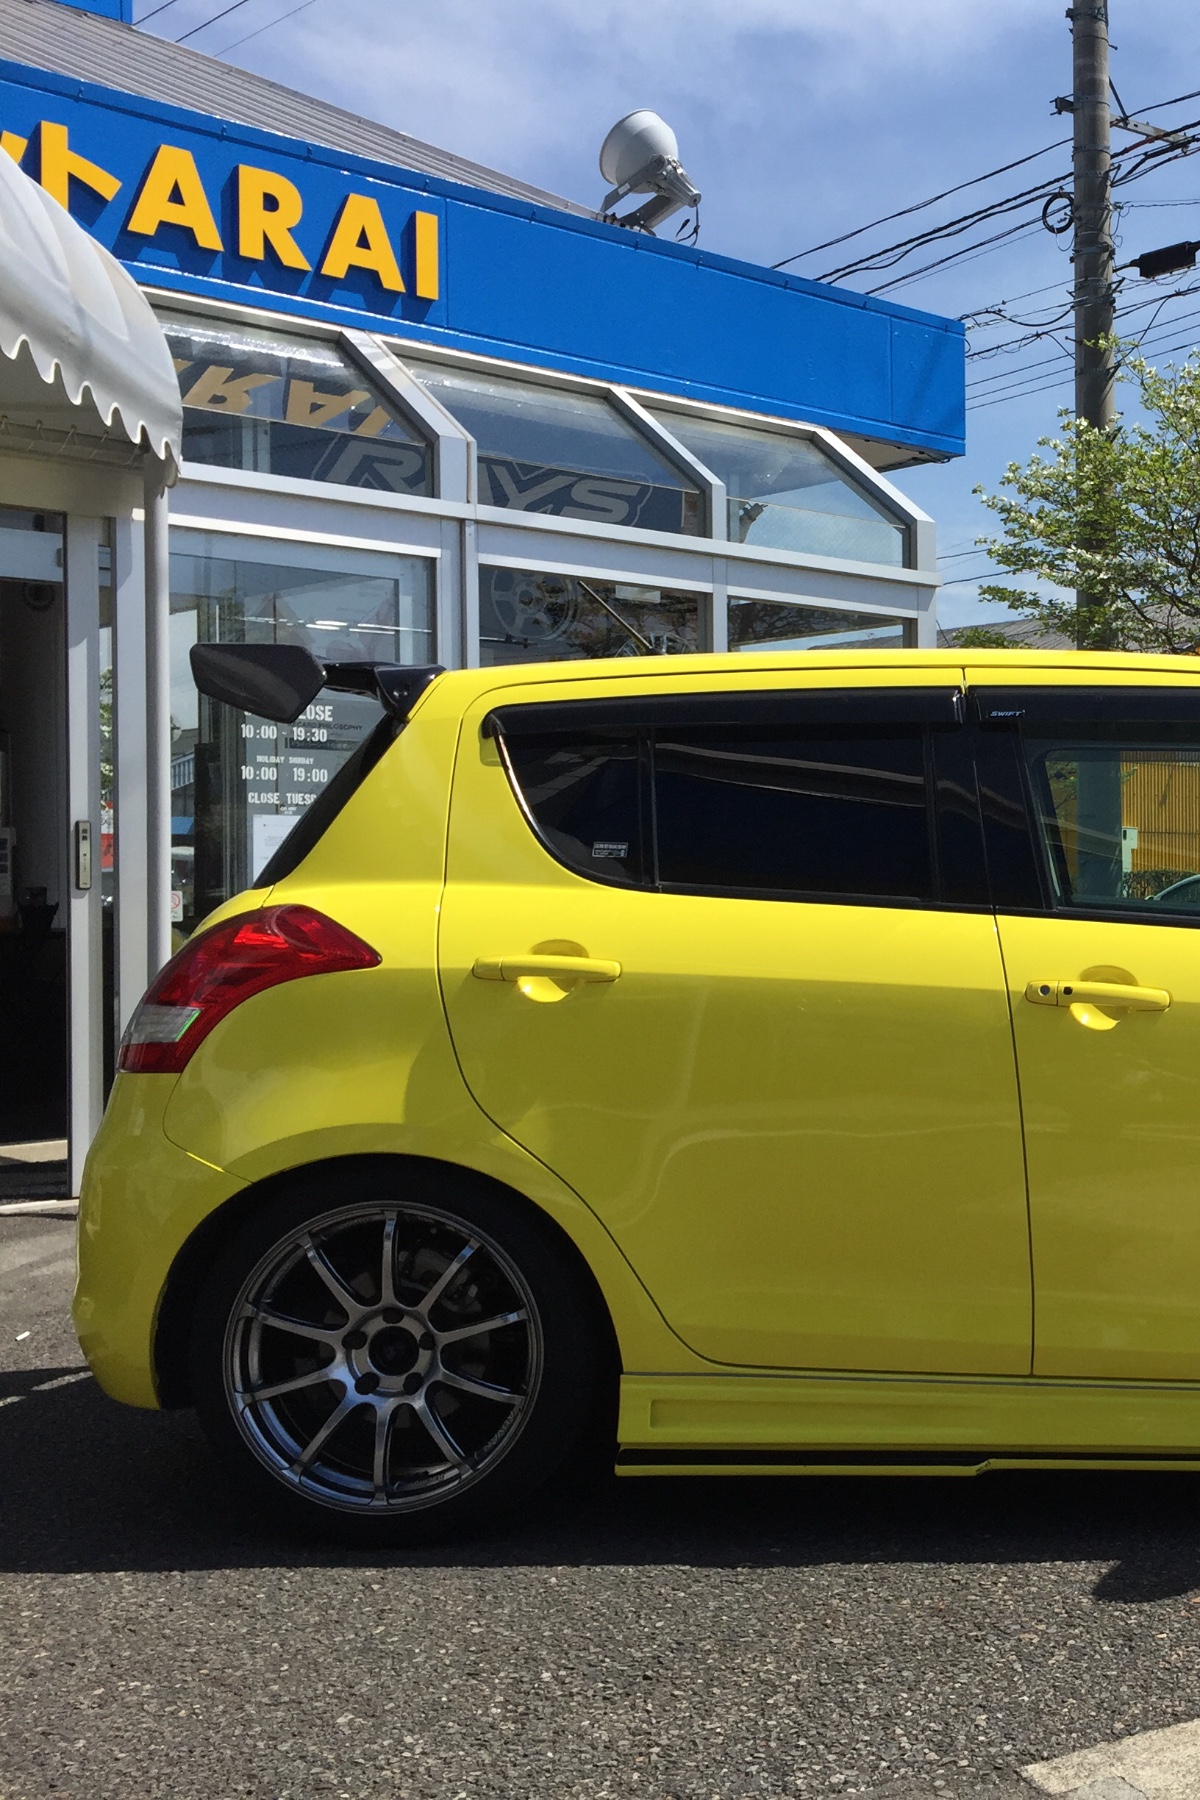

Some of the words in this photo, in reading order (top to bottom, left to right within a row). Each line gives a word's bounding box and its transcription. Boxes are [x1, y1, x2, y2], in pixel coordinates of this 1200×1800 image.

[241, 723, 278, 740] 10:00
[292, 726, 328, 742] 19:30
[256, 755, 285, 764] HOLIDAY
[288, 756, 315, 765] SUNDAY
[241, 765, 278, 781] 10:00
[292, 767, 329, 783] 19:00
[247, 792, 280, 805] CLOSE
